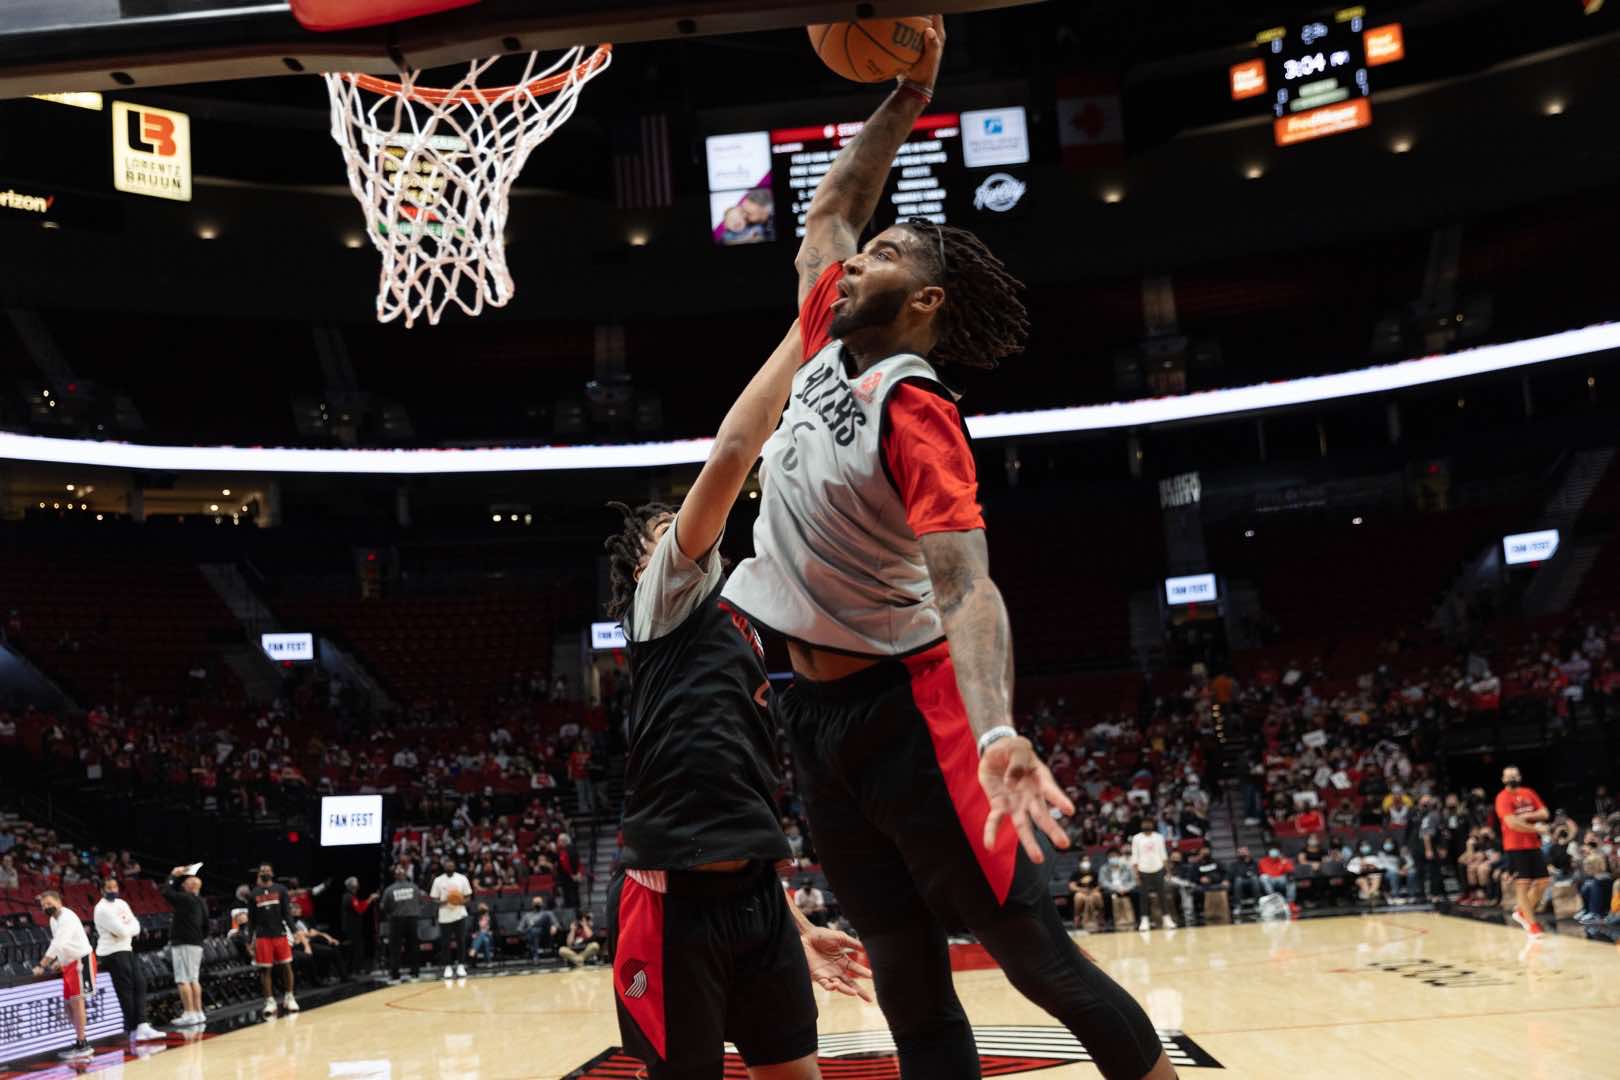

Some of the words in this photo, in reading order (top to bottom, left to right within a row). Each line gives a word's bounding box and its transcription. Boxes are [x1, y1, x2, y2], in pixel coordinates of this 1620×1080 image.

[1284, 52, 1326, 79] 3:04
[125, 170, 182, 190] BRUUN
[267, 642, 284, 652] FAN
[286, 641, 306, 652] FEST
[329, 813, 348, 829] FAN
[350, 812, 375, 828] FEST
